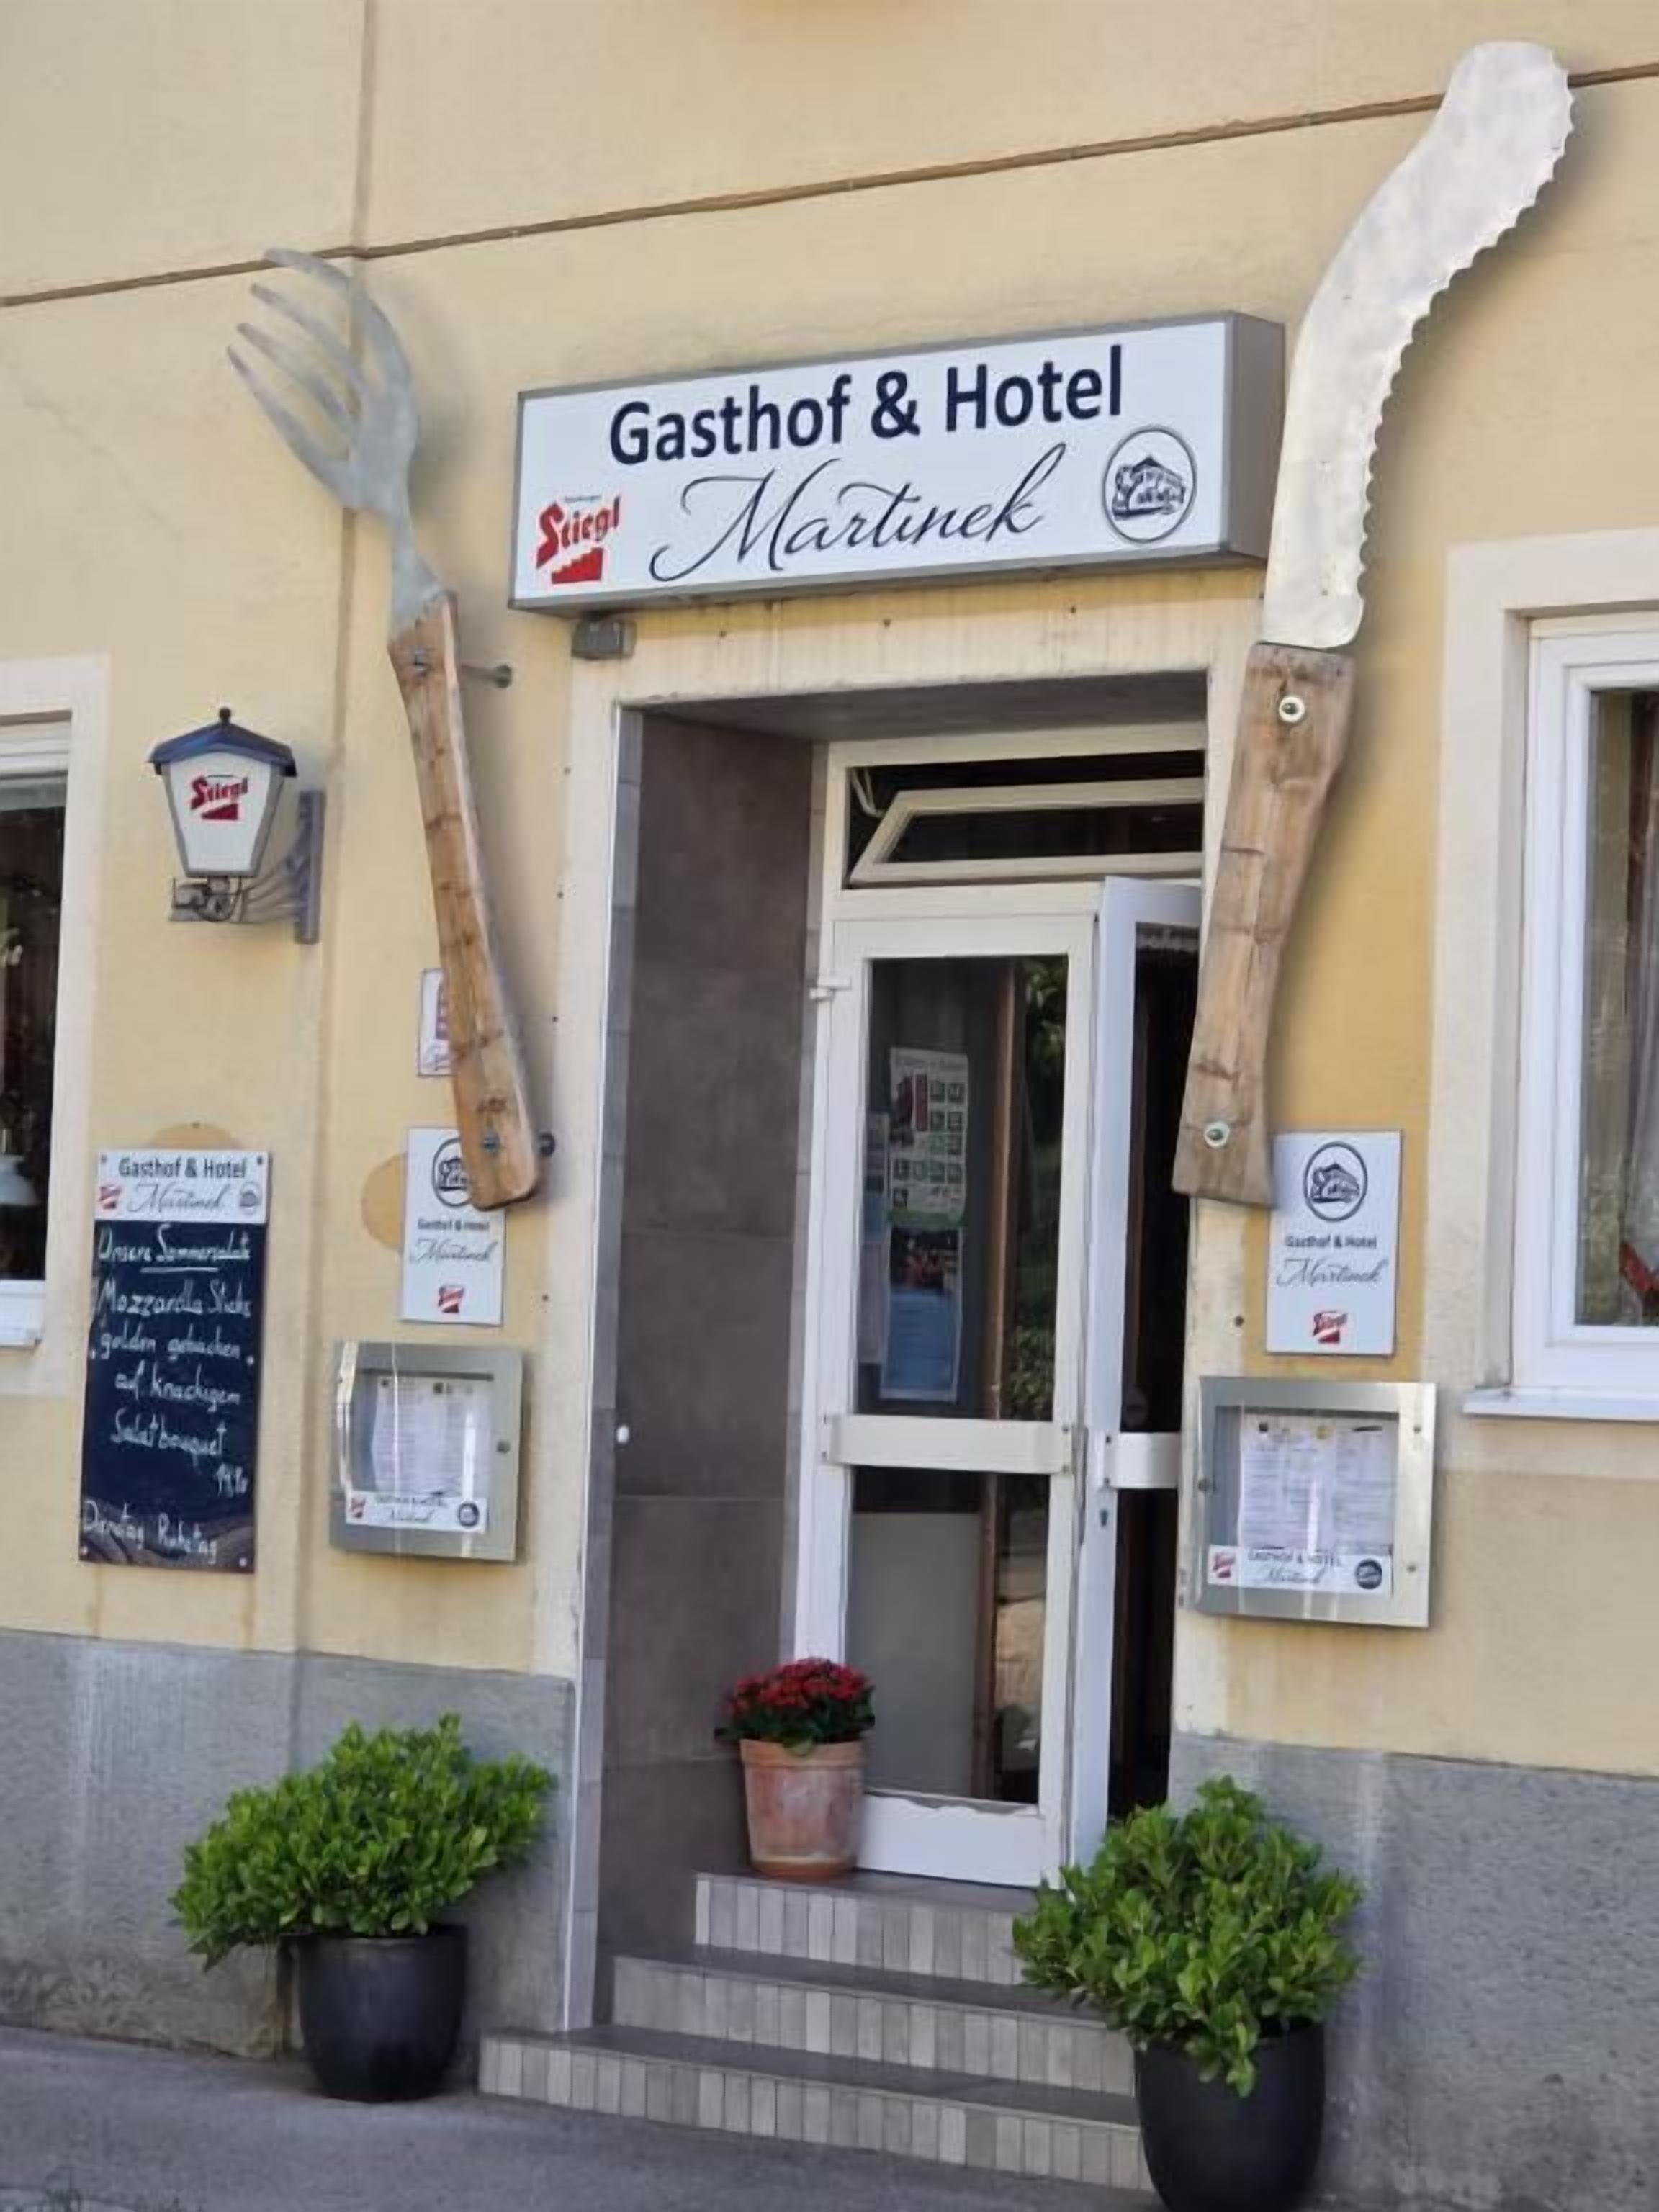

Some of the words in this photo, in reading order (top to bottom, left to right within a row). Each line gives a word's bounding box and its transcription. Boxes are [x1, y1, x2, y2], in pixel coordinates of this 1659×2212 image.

[611, 374, 852, 464] Gasthof
[871, 370, 920, 439] &
[946, 344, 1121, 432] Hotel
[536, 494, 619, 569] Stiegl
[649, 442, 1066, 581] Martinek
[119, 1158, 180, 1178] Gasthof
[185, 1158, 197, 1178] &
[204, 1157, 247, 1178] Hotel
